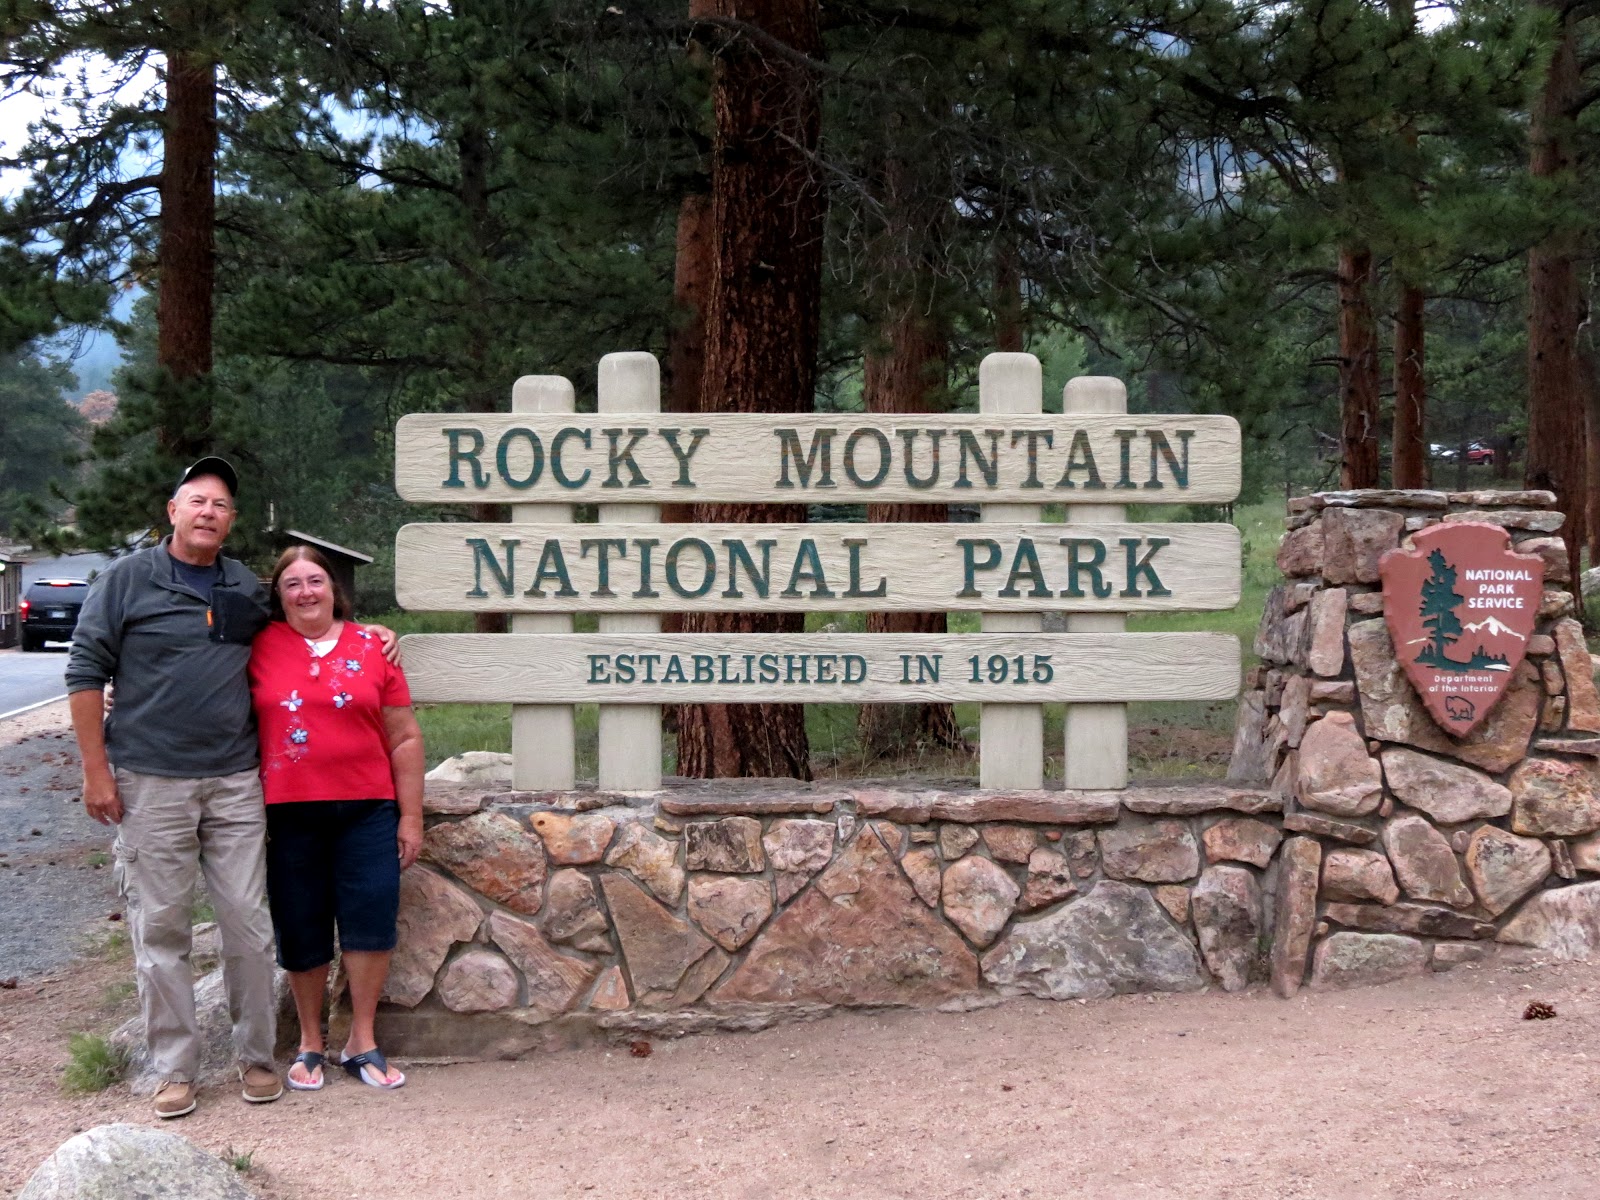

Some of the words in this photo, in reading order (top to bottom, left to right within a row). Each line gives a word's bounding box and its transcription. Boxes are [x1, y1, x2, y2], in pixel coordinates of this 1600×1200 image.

[442, 427, 710, 490] ROCKY
[774, 427, 1195, 490] MOUNTAIN
[465, 537, 888, 599] NATIONAL
[956, 537, 1172, 599] PARK
[1465, 570, 1532, 581] NATIONAL
[1479, 584, 1515, 595] PARK
[1468, 598, 1524, 608] SERVICE
[586, 654, 867, 685] ESTABLISHED
[900, 654, 944, 684] IN
[968, 654, 1055, 684] 1915
[1434, 675, 1493, 684] Department
